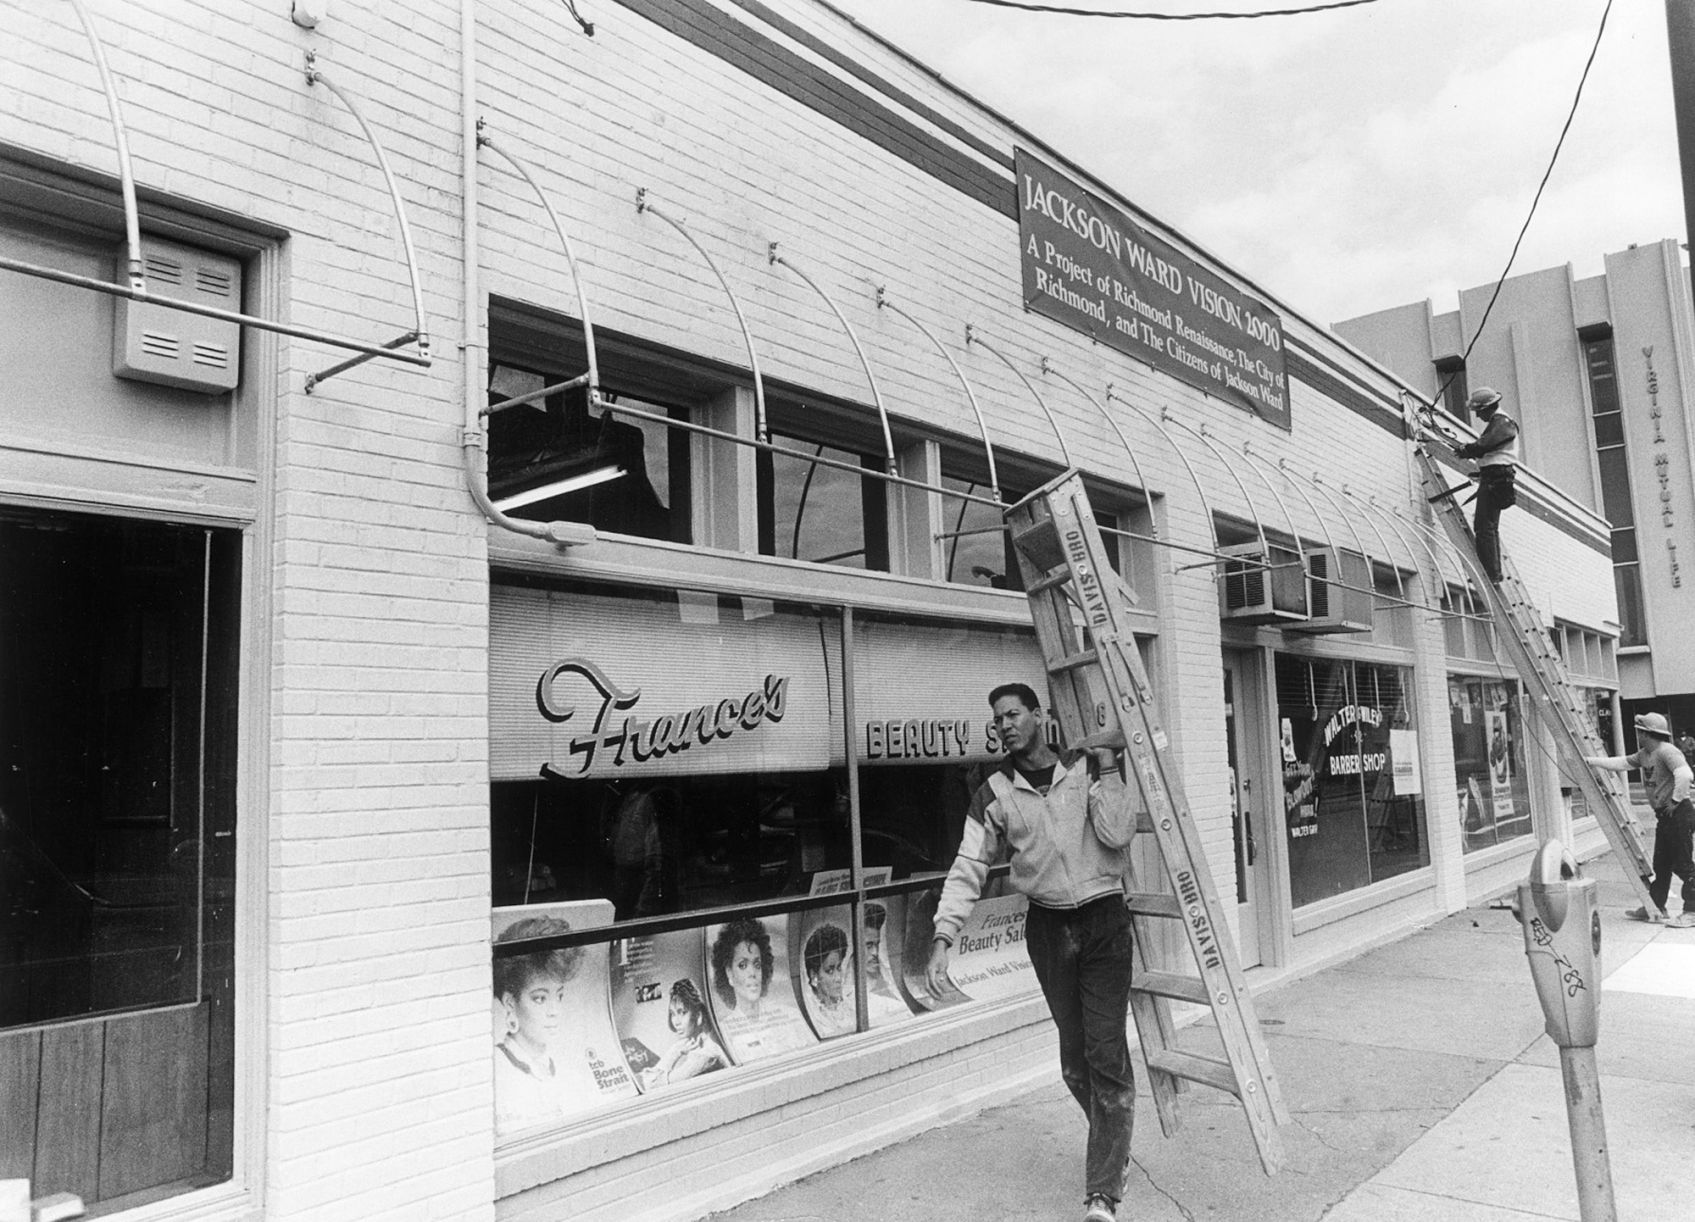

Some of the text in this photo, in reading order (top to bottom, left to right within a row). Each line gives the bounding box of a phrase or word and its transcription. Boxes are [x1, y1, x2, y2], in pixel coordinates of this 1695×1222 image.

[1024, 173, 1280, 352] JACKSON WARD VISION 2000
[1027, 233, 1040, 259] A
[1044, 240, 1093, 286] Project
[1097, 275, 1111, 296] of
[1113, 279, 1173, 330] Richmond
[1236, 348, 1255, 373] The
[1256, 360, 1274, 387] City
[1275, 372, 1285, 389] of
[1116, 315, 1139, 339] and
[1140, 321, 1164, 352] The
[1166, 336, 1209, 375] Citizens
[1210, 362, 1222, 381] of
[1224, 365, 1259, 399] Jackson
[1260, 383, 1284, 411] Ward
[1065, 530, 1107, 625] DAVIS BRO
[866, 719, 970, 760] BEAUTY
[1324, 705, 1356, 747] WALTER
[1329, 754, 1361, 776] BARBER
[1363, 752, 1385, 772] SHOP
[1177, 871, 1220, 969] DAVIS BRO
[960, 933, 1002, 955] Beauty
[953, 974, 988, 987] Jackson
[986, 963, 1011, 975] Ward
[593, 1065, 625, 1080] Bone
[597, 1073, 630, 1090] Strait
